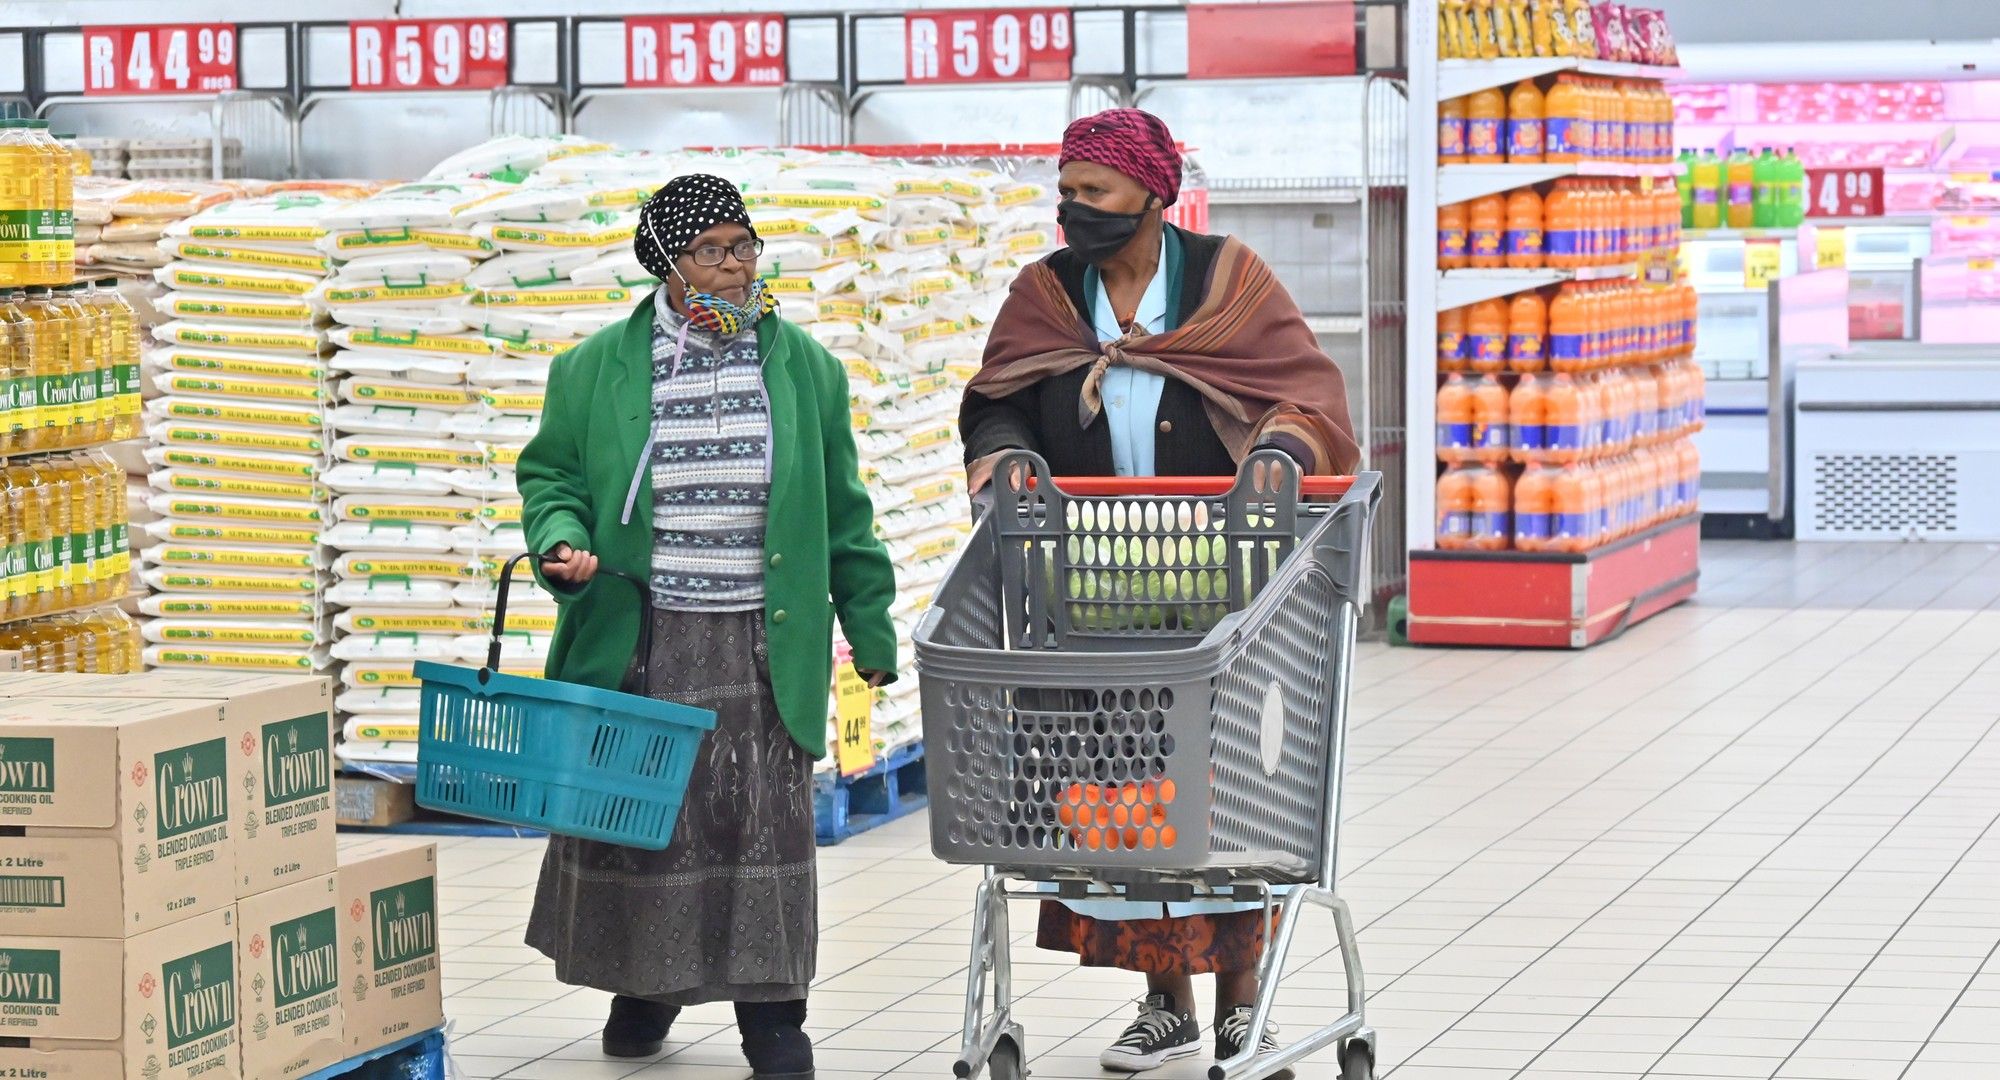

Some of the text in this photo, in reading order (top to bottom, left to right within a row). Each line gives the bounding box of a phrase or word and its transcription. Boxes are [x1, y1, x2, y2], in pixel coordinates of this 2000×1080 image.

[356, 23, 505, 86] R 59 99
[632, 20, 782, 83] R 59 99
[911, 13, 1069, 79] R 59 99
[90, 28, 233, 89] R 44 99
[1845, 172, 1872, 198] 99
[0, 224, 31, 239] own
[422, 236, 470, 246] MAIZE MEAL
[238, 253, 313, 267] SUPER MAIZE MEAL
[550, 293, 575, 301] MAIZE
[577, 292, 600, 300] MEAL
[229, 363, 301, 375] SUPER MAIZE MEAL
[42, 381, 73, 404] Crown
[72, 378, 97, 401] Crown
[227, 410, 301, 422] SUPER MAIZE MEAL
[226, 435, 300, 447] SUPER MAIZE MEAL
[222, 460, 246, 468] SUPER
[275, 464, 295, 472] MEAL
[227, 482, 302, 494] SUPER MAIZE MEAL
[228, 507, 252, 515] SUPER
[255, 509, 278, 517] MAIZE
[228, 530, 304, 540] SUPER MAIZE MEAL
[247, 555, 272, 563] MAIZE
[274, 556, 294, 564] MEAL
[246, 632, 270, 640] MAIZE
[216, 655, 289, 665] SUPER MAIZE MEAL
[844, 718, 860, 748] 44
[0, 761, 48, 788] own
[267, 734, 327, 799] Crown
[39, 794, 54, 804] OIL
[160, 762, 225, 830] Crown
[2, 806, 32, 815] REFINED
[265, 796, 330, 825] BLENDED COOKING OIL
[281, 818, 317, 838] TRIPLE REFINED
[157, 826, 228, 858] BLENDED COOKING OIL
[6, 857, 44, 867] 2 Litre
[175, 849, 214, 871] TRIPLE REFINED
[273, 867, 280, 876] 12
[285, 865, 289, 873] 2
[289, 862, 300, 872] Litre
[166, 902, 173, 911] 12
[179, 899, 183, 908] 2
[183, 896, 196, 907] Litre
[375, 900, 432, 961] Crown
[276, 934, 336, 998] Crown
[374, 968, 402, 987] BLENDED
[403, 961, 427, 977] COOKING
[0, 972, 54, 999] own
[391, 981, 425, 998] TRIPLE REFINED
[3, 1004, 60, 1016] COOKING OIL
[169, 971, 232, 1039] Crown
[8, 1018, 38, 1026] REFINED
[168, 1043, 200, 1068] BLENDED
[201, 1034, 228, 1056] COOKING
[10, 1068, 16, 1077] 2
[20, 1068, 47, 1078] Litre
[187, 1061, 205, 1078] TRIPLE
